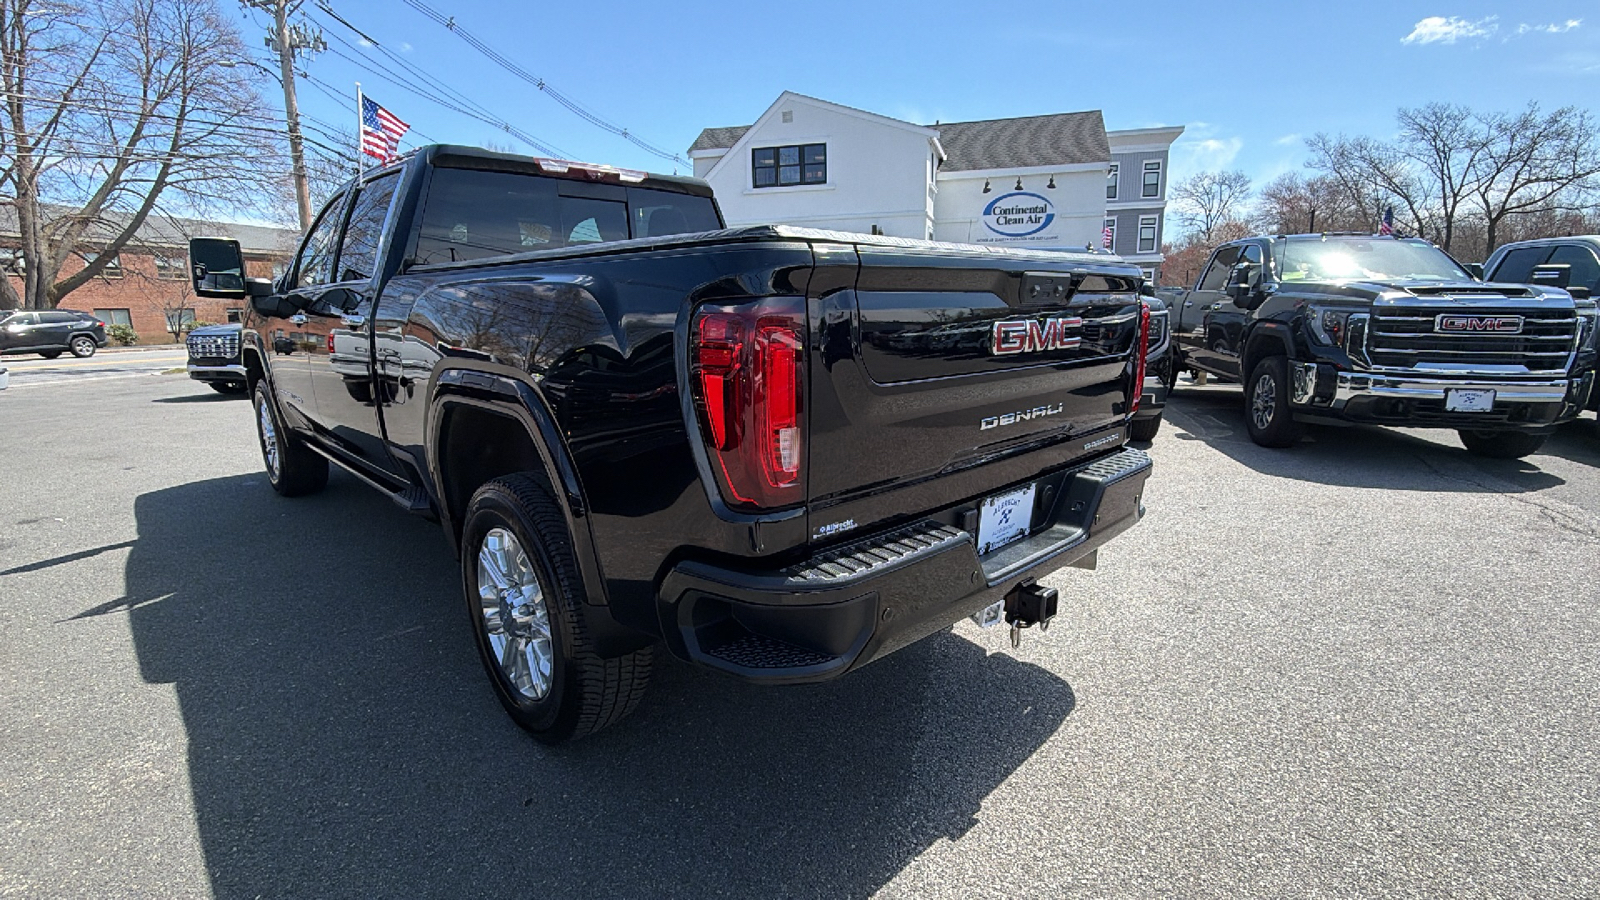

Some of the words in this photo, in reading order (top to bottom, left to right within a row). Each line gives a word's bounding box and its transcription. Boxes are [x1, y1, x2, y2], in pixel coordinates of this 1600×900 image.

[992, 203, 1048, 216] Continental
[996, 215, 1024, 226] Clean
[1026, 213, 1043, 224] Air
[1441, 317, 1519, 331] GMC
[993, 317, 1082, 356] GMC
[979, 402, 1063, 431] DENALI
